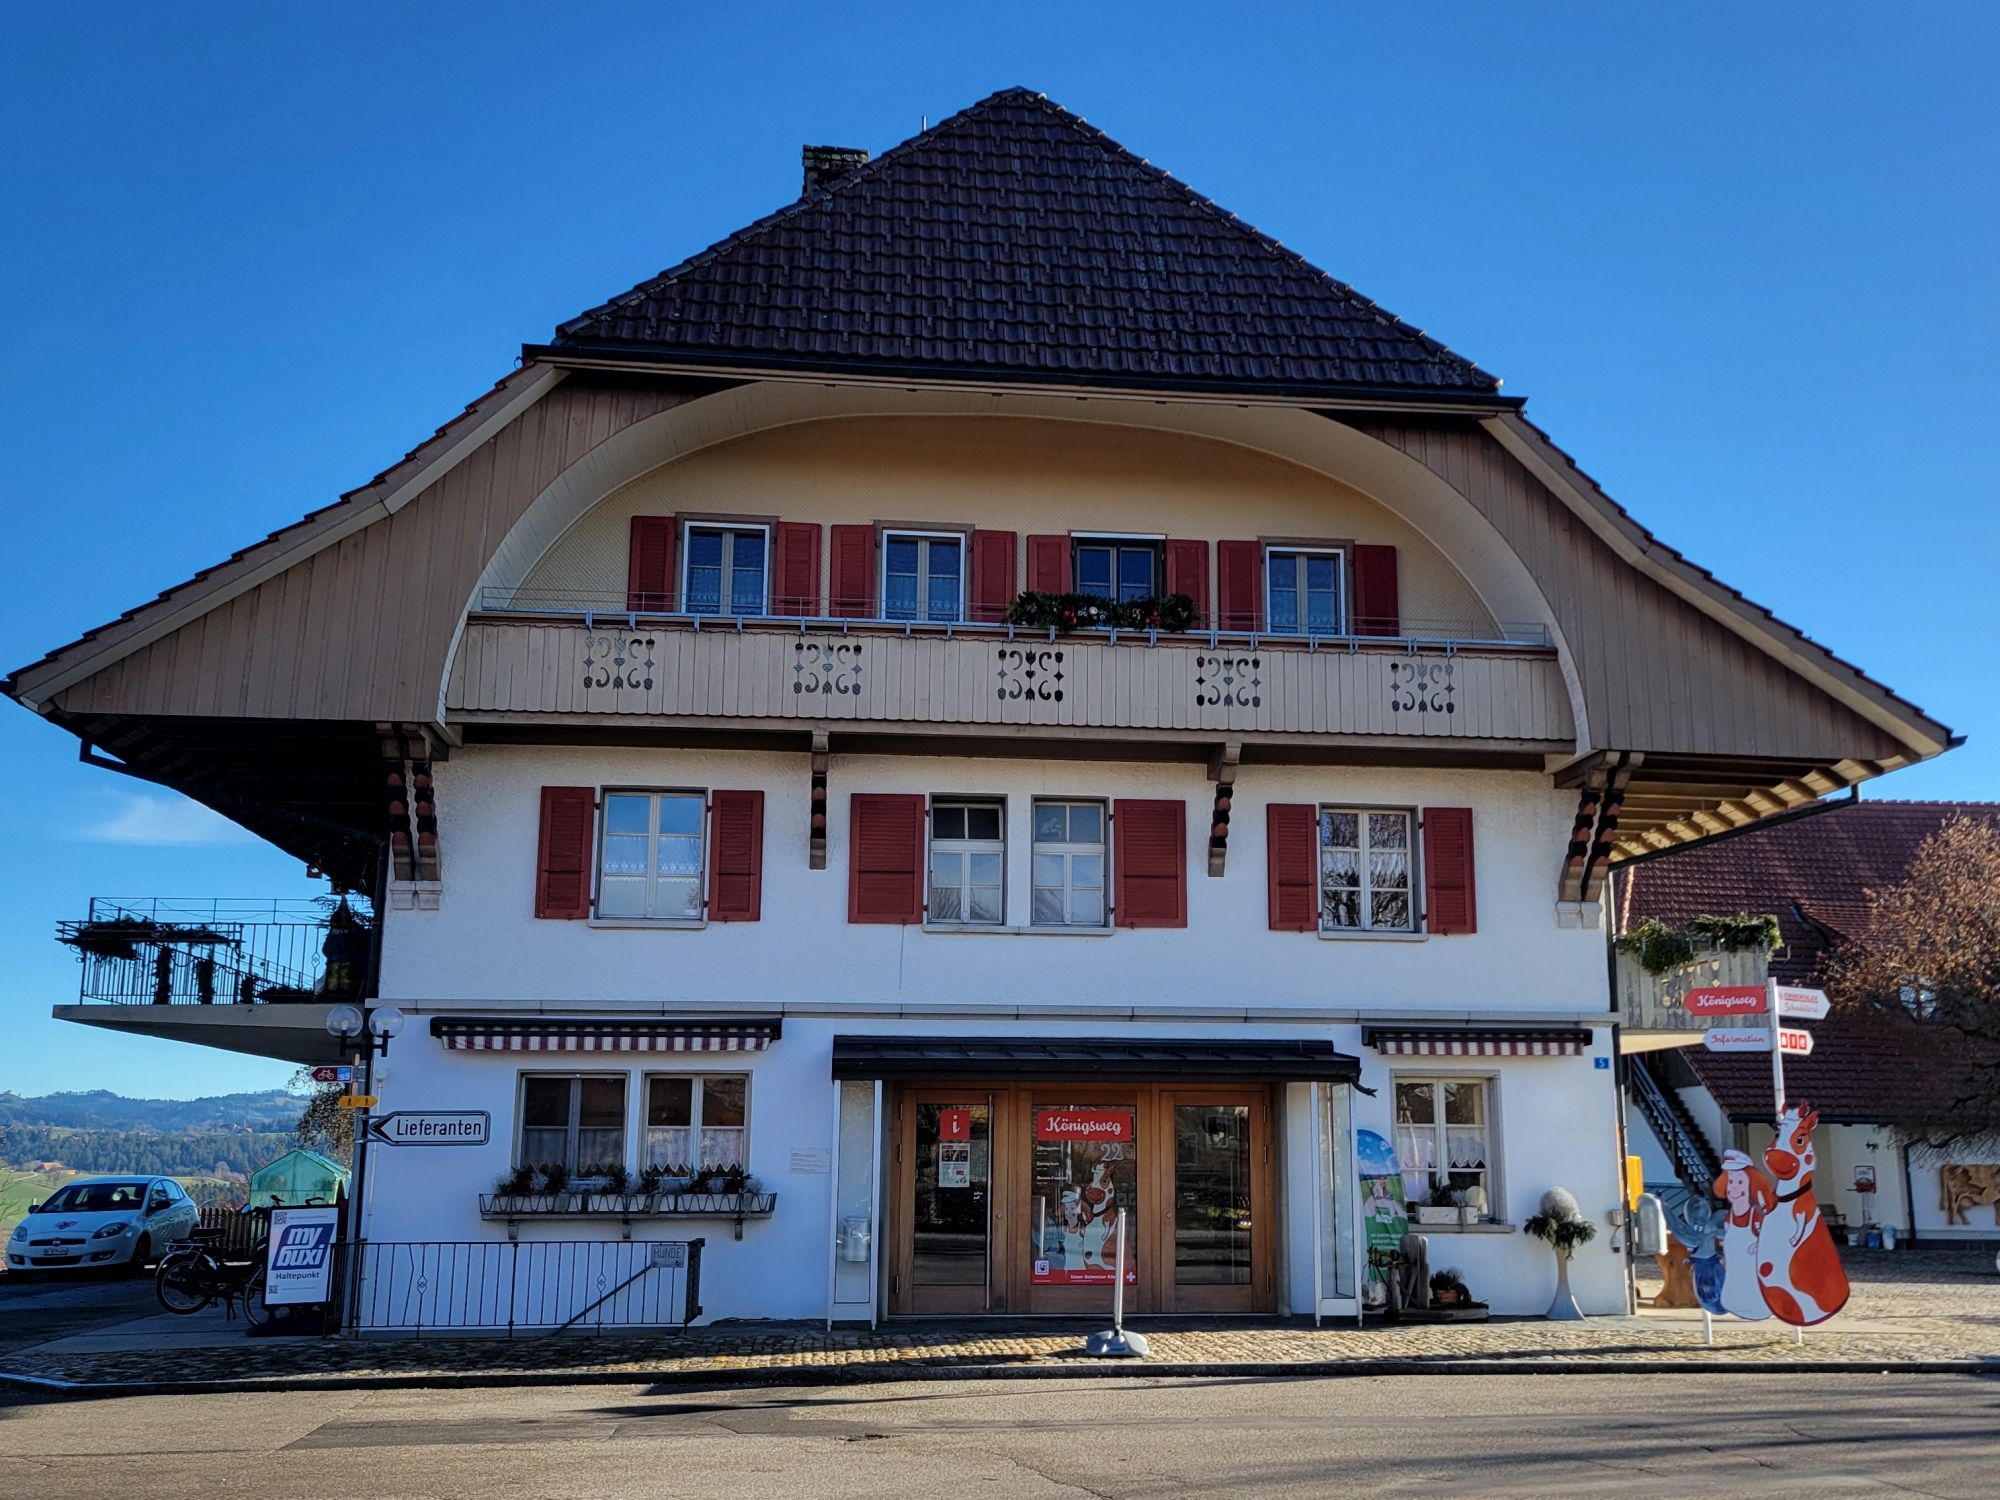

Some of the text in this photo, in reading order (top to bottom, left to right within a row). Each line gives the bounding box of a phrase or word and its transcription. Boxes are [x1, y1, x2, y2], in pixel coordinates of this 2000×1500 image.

[1696, 994, 1758, 1008] Königsweg
[1711, 1034, 1765, 1045] Information
[1599, 1058, 1605, 1068] 5
[396, 1119, 482, 1136] Lieferanten
[952, 1114, 960, 1134] i
[1045, 1116, 1122, 1135] Königsweg
[1100, 1143, 1124, 1161] 22
[286, 1227, 323, 1248] my
[276, 1244, 325, 1267] buxi
[275, 1271, 320, 1280] Haltepunkt
